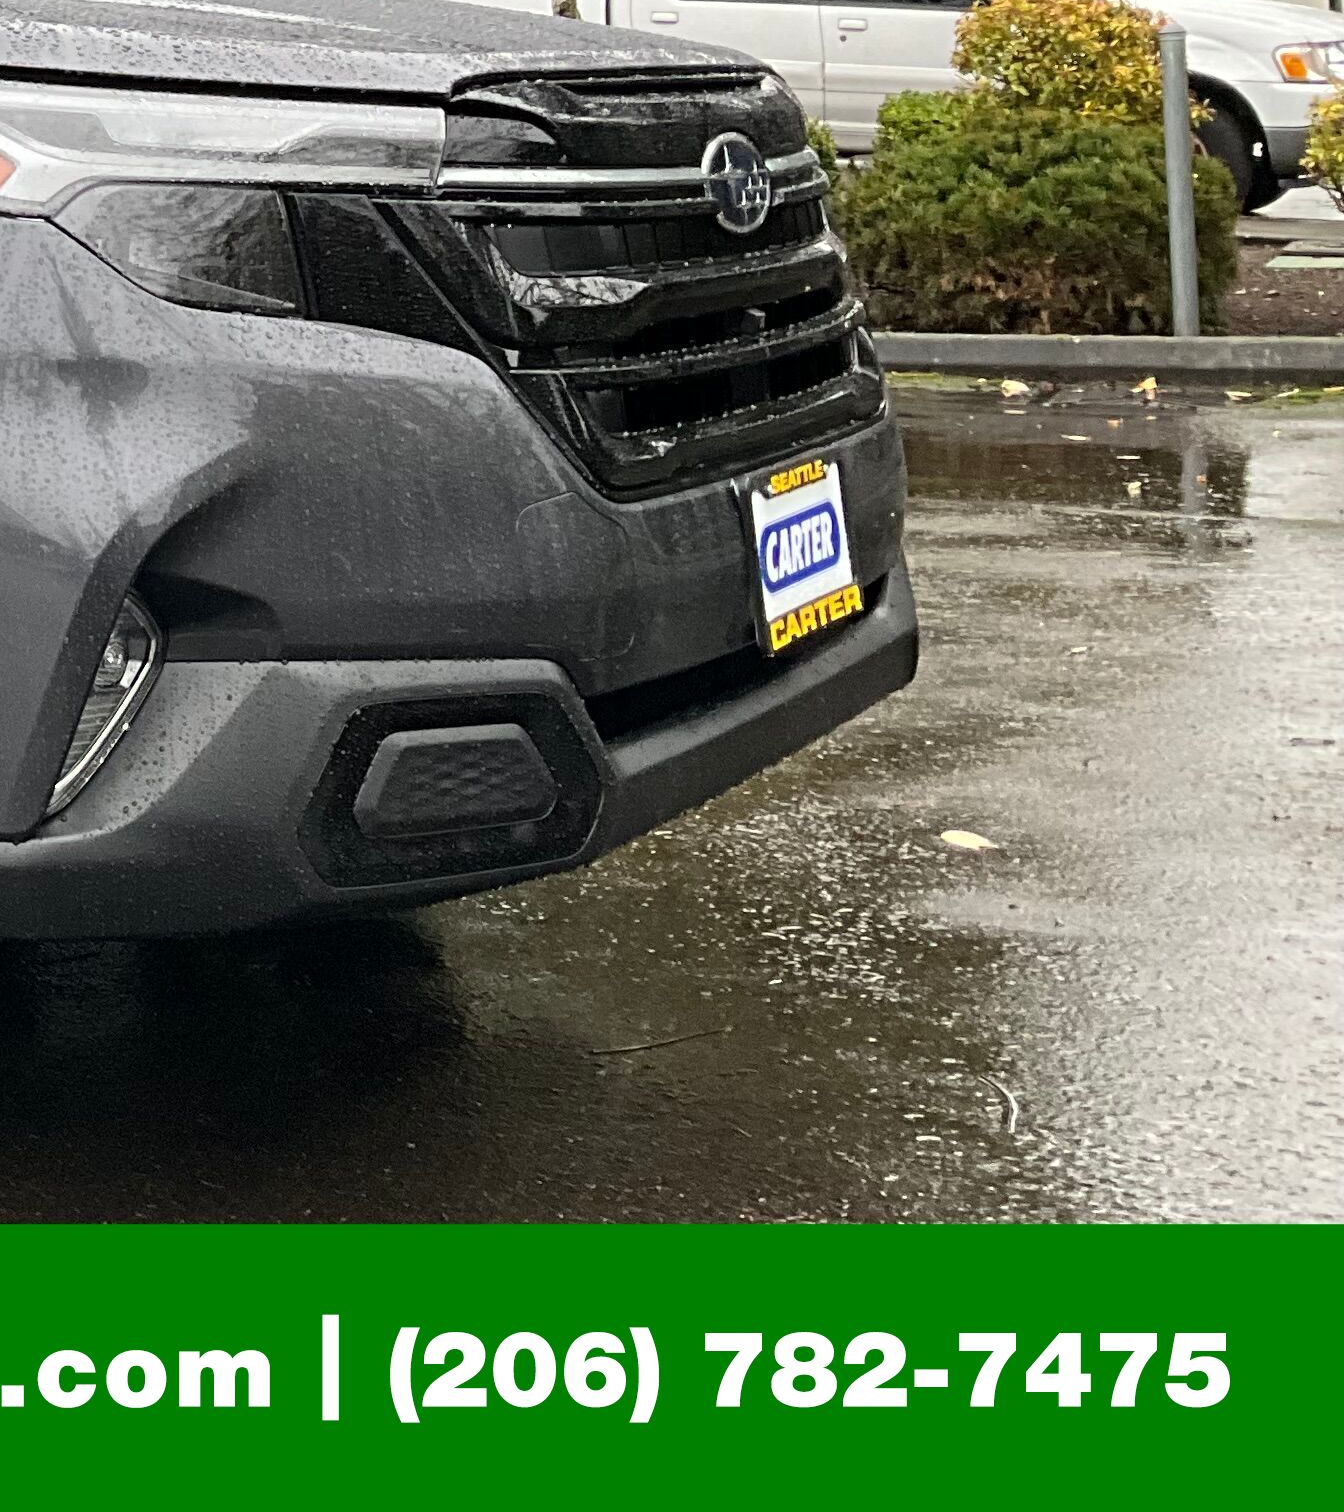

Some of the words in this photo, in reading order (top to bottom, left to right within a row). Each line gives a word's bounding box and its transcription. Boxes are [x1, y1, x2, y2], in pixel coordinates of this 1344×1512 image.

[769, 459, 825, 495] SEATTLE
[765, 511, 835, 584] CARTER
[770, 584, 864, 651] CARTER
